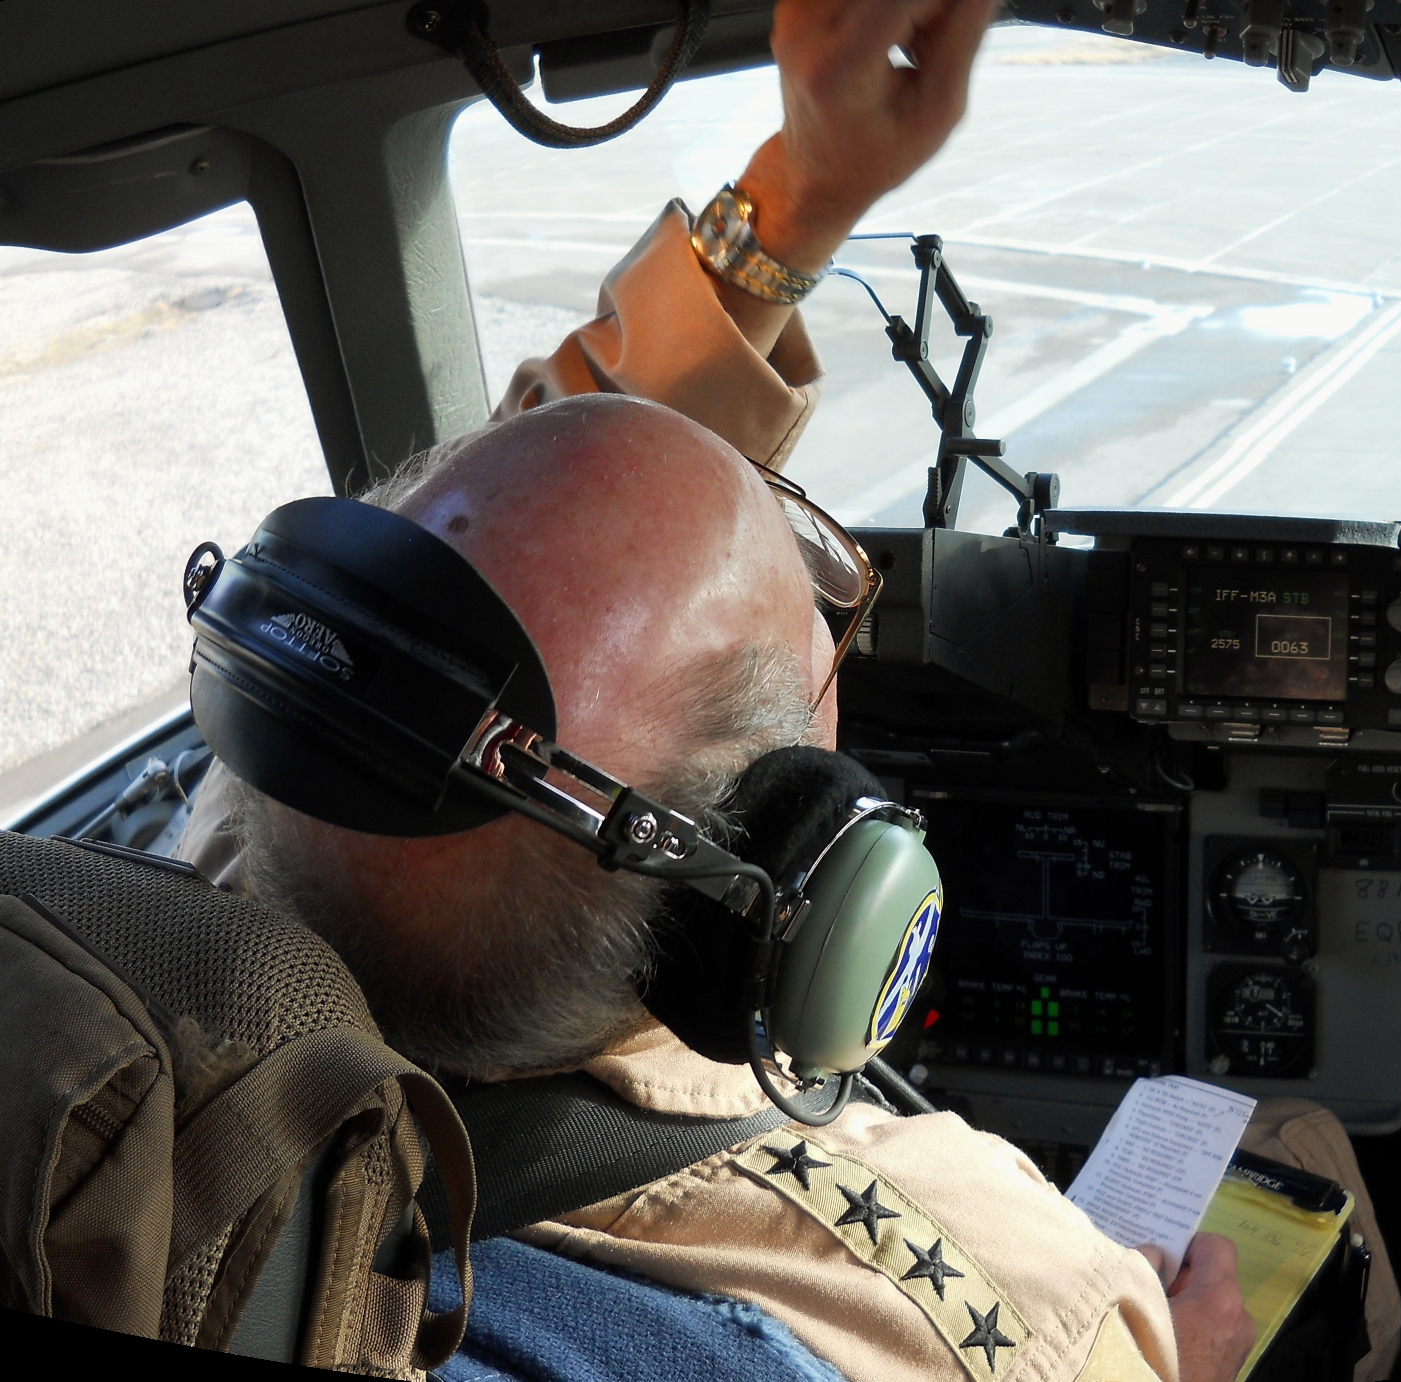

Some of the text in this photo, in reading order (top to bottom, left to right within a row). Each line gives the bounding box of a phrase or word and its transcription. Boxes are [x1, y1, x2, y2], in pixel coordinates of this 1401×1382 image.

[1216, 589, 1309, 604] IFF-M3A STB
[295, 613, 338, 646] AERO
[1211, 639, 1241, 649] 2575
[1271, 640, 1308, 654] 0063
[260, 623, 355, 681] SOFTTOP
[1024, 811, 1069, 820] RUD TRIM
[1016, 823, 1026, 831] NL
[1092, 839, 1105, 848] NU
[1108, 851, 1132, 860] STAB
[1109, 861, 1131, 870] TRIM
[1092, 871, 1105, 879] ND
[1135, 874, 1149, 883] AIL
[1131, 886, 1153, 895] TRIM
[1021, 939, 1067, 951] FLAPS UP
[1023, 950, 1073, 962] INDEX 100
[992, 982, 1013, 992] TEMP
[1094, 991, 1117, 1001] TEMP
[1229, 1162, 1285, 1191] AMBRIDGE
